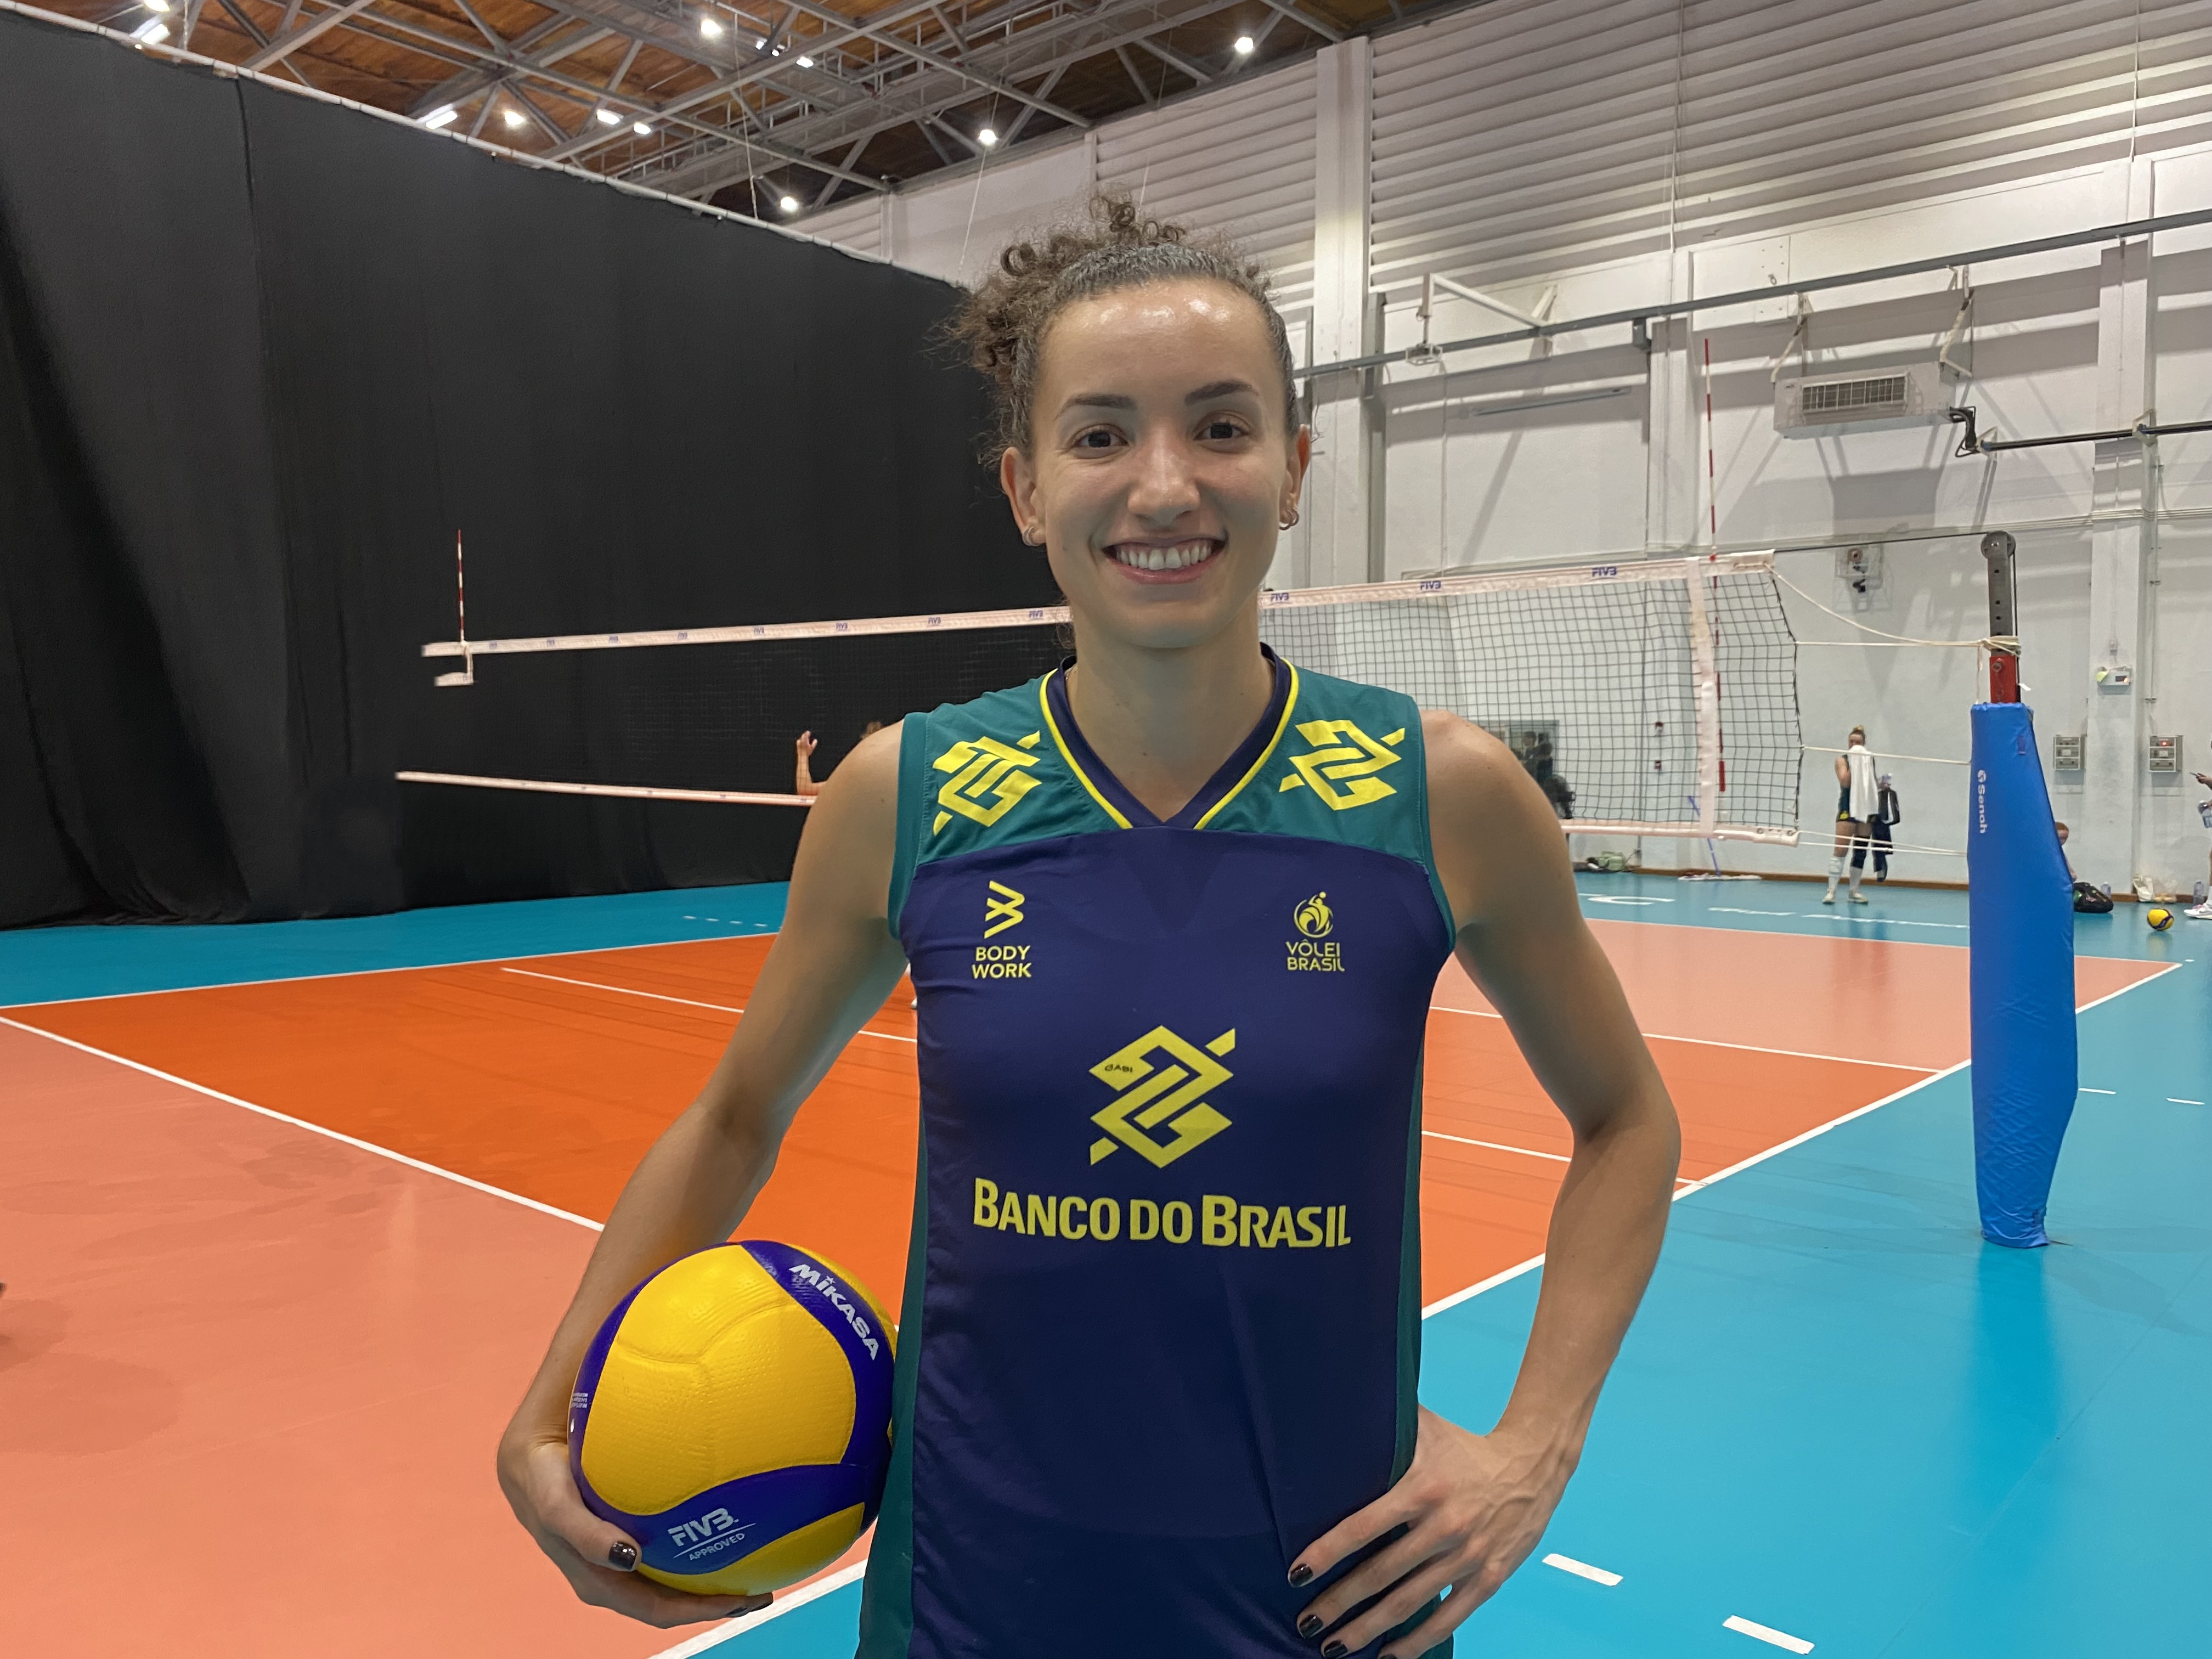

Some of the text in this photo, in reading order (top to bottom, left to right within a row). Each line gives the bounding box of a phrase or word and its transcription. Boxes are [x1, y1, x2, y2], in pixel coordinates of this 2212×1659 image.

[1592, 566, 1617, 577] FIVB
[1420, 580, 1441, 590] FIVB
[975, 945, 1031, 961] BODY
[1285, 938, 1340, 957] VÔLEI
[972, 962, 1032, 979] WORK
[1287, 957, 1345, 972] BRASIL
[973, 1177, 1351, 1248] BANCO DO BRASIL
[788, 1263, 879, 1361] MIKASA
[668, 1508, 734, 1547] FIVB
[689, 1533, 745, 1561] APPROVED
